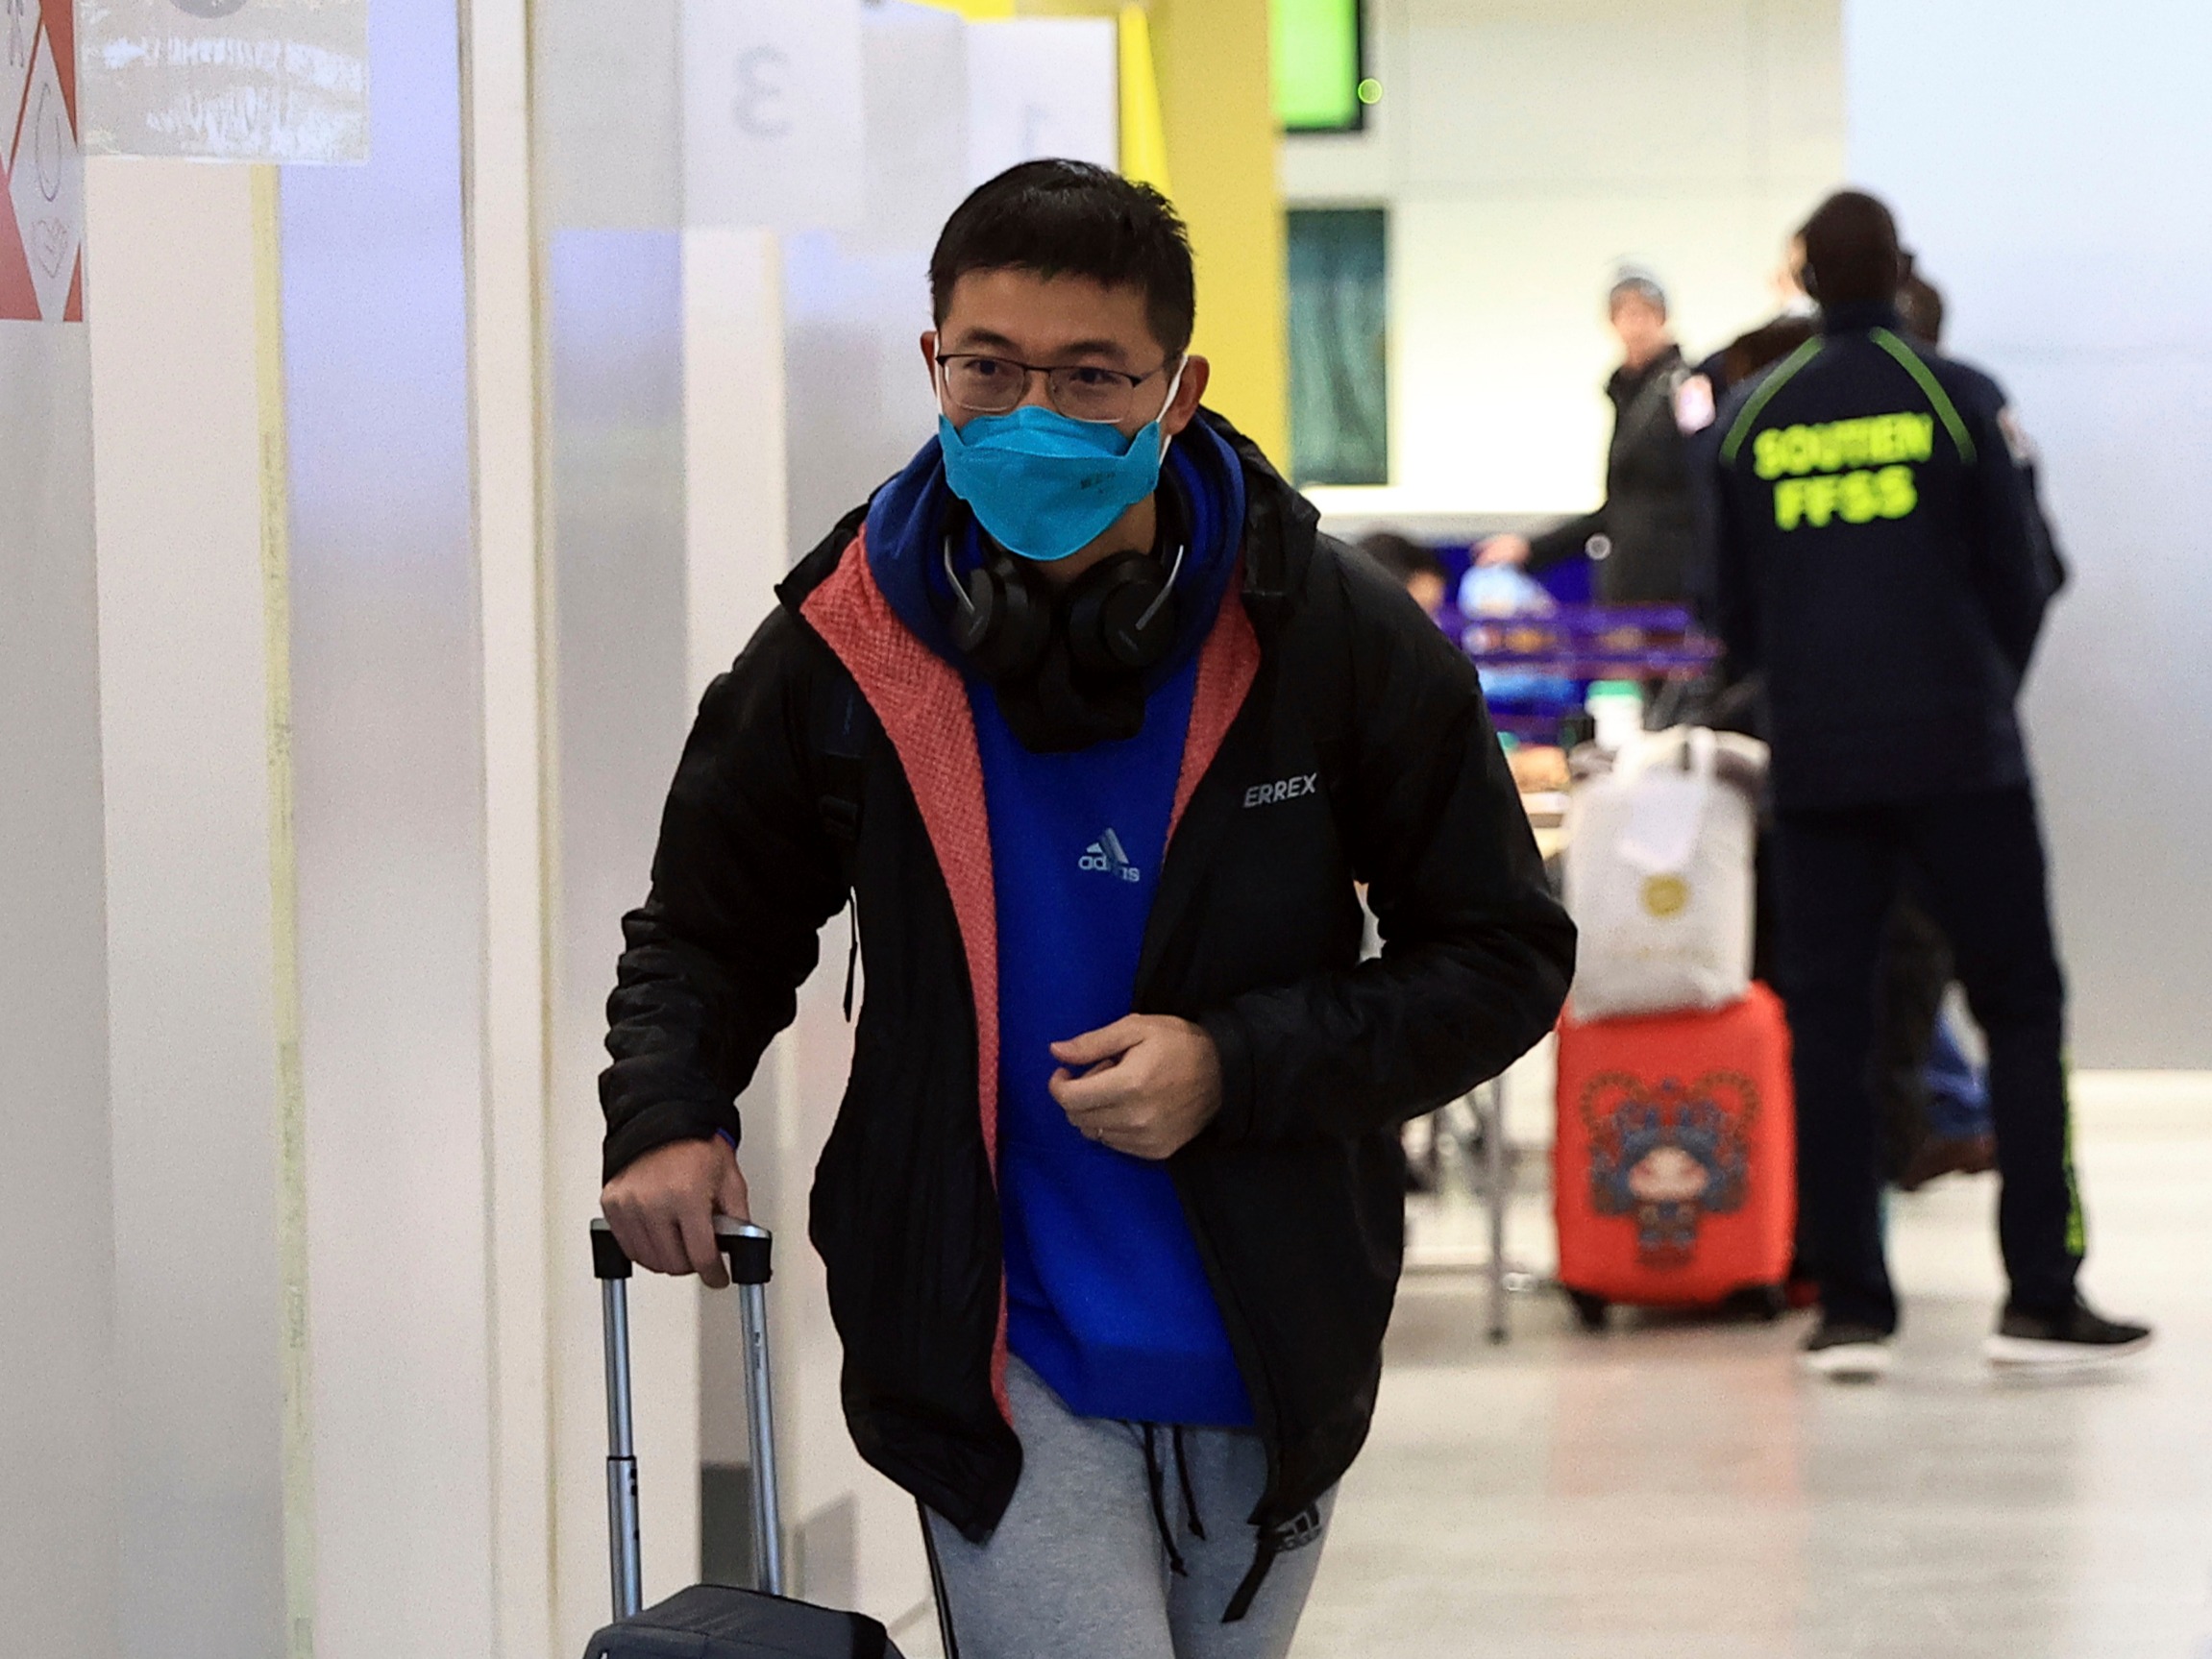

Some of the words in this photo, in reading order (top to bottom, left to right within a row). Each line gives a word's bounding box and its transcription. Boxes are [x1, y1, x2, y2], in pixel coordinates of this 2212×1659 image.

[1774, 463, 1919, 532] FFSS
[1243, 771, 1317, 808] ERREX
[1078, 852, 1140, 883] ads
